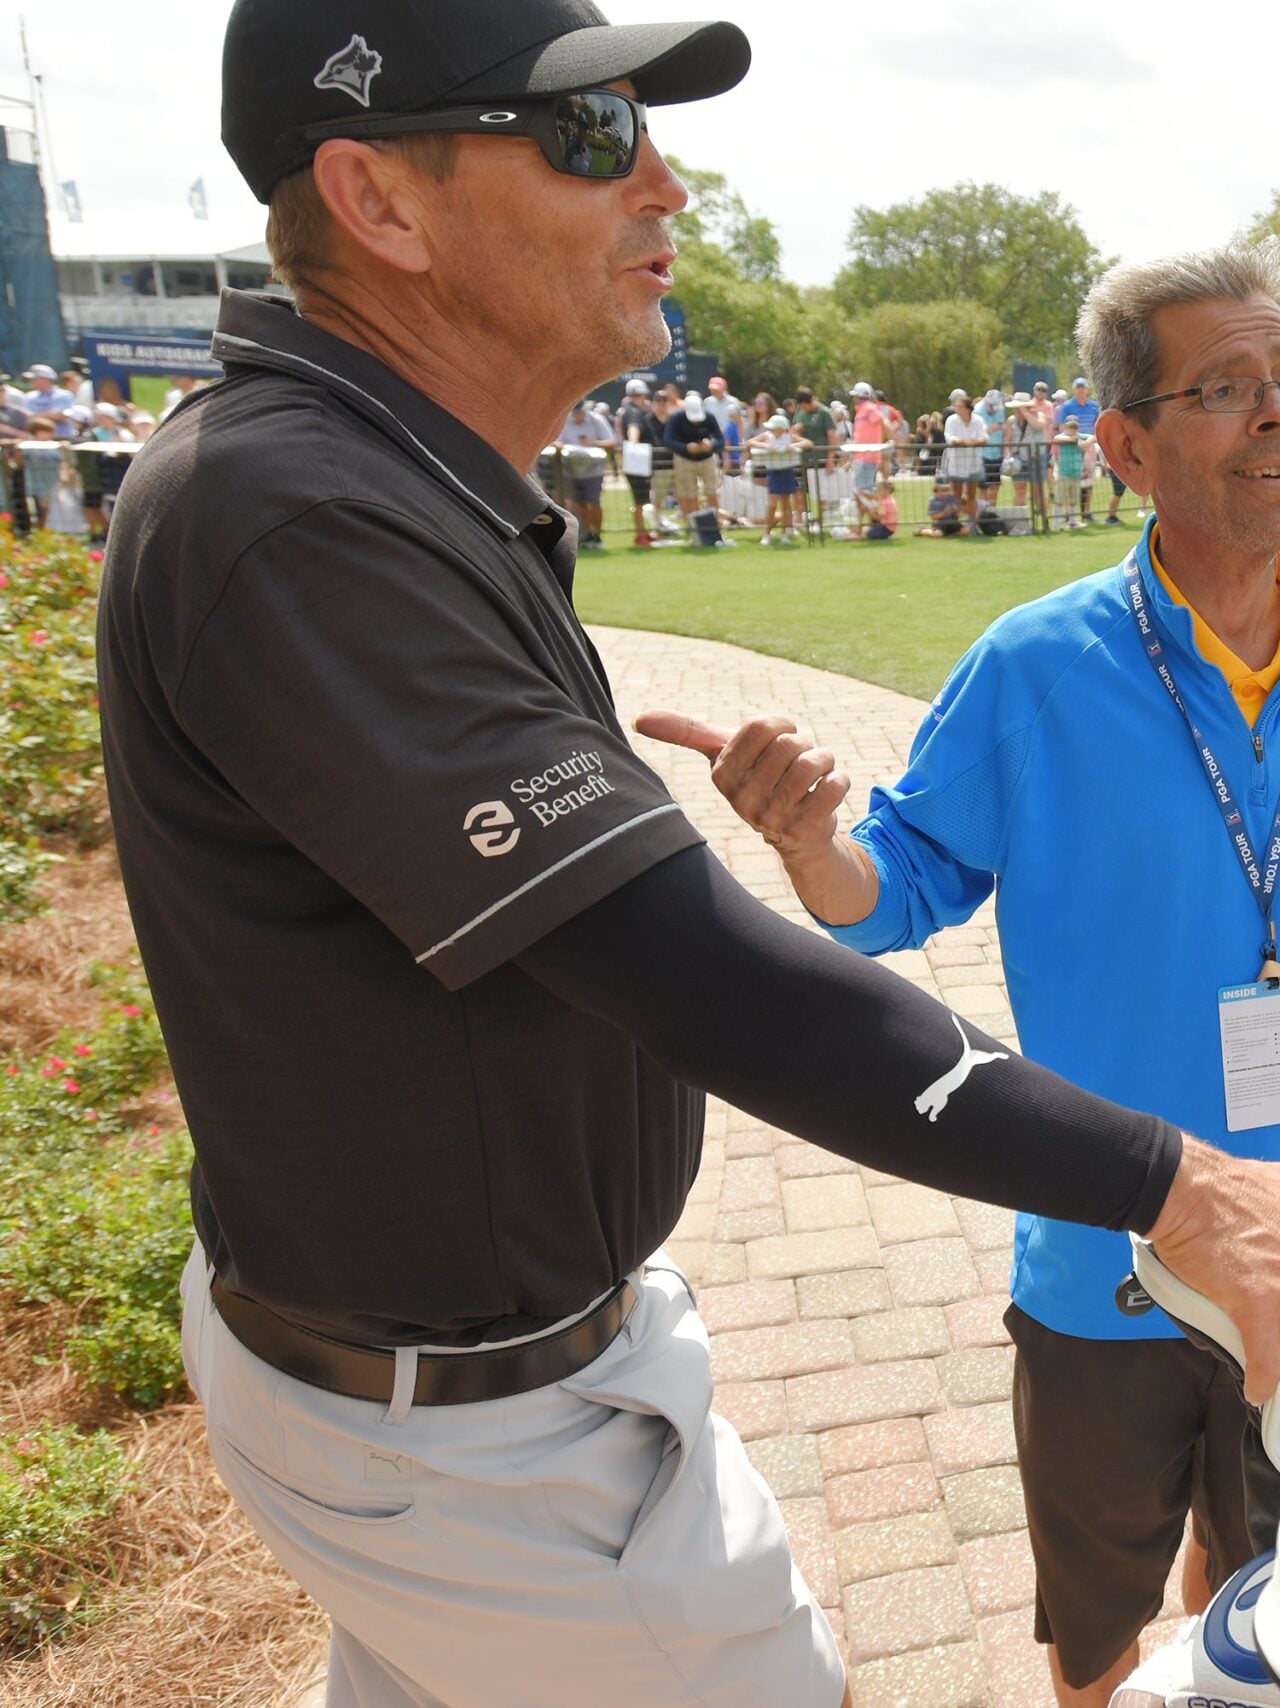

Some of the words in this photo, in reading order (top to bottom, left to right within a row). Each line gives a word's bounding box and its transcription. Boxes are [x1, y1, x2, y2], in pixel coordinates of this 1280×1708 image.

[1129, 583, 1144, 611] TOUR
[1137, 611, 1151, 635] PGA
[1158, 664, 1177, 695] TOUR
[510, 749, 605, 804] Security
[1202, 747, 1223, 780] TOUR
[528, 773, 616, 828] Benefit
[1215, 778, 1231, 803] PGA
[1235, 832, 1254, 865] TOUR
[1248, 863, 1260, 887] PGA
[1263, 862, 1278, 894] TOUR
[1222, 987, 1257, 1000] INSIDE
